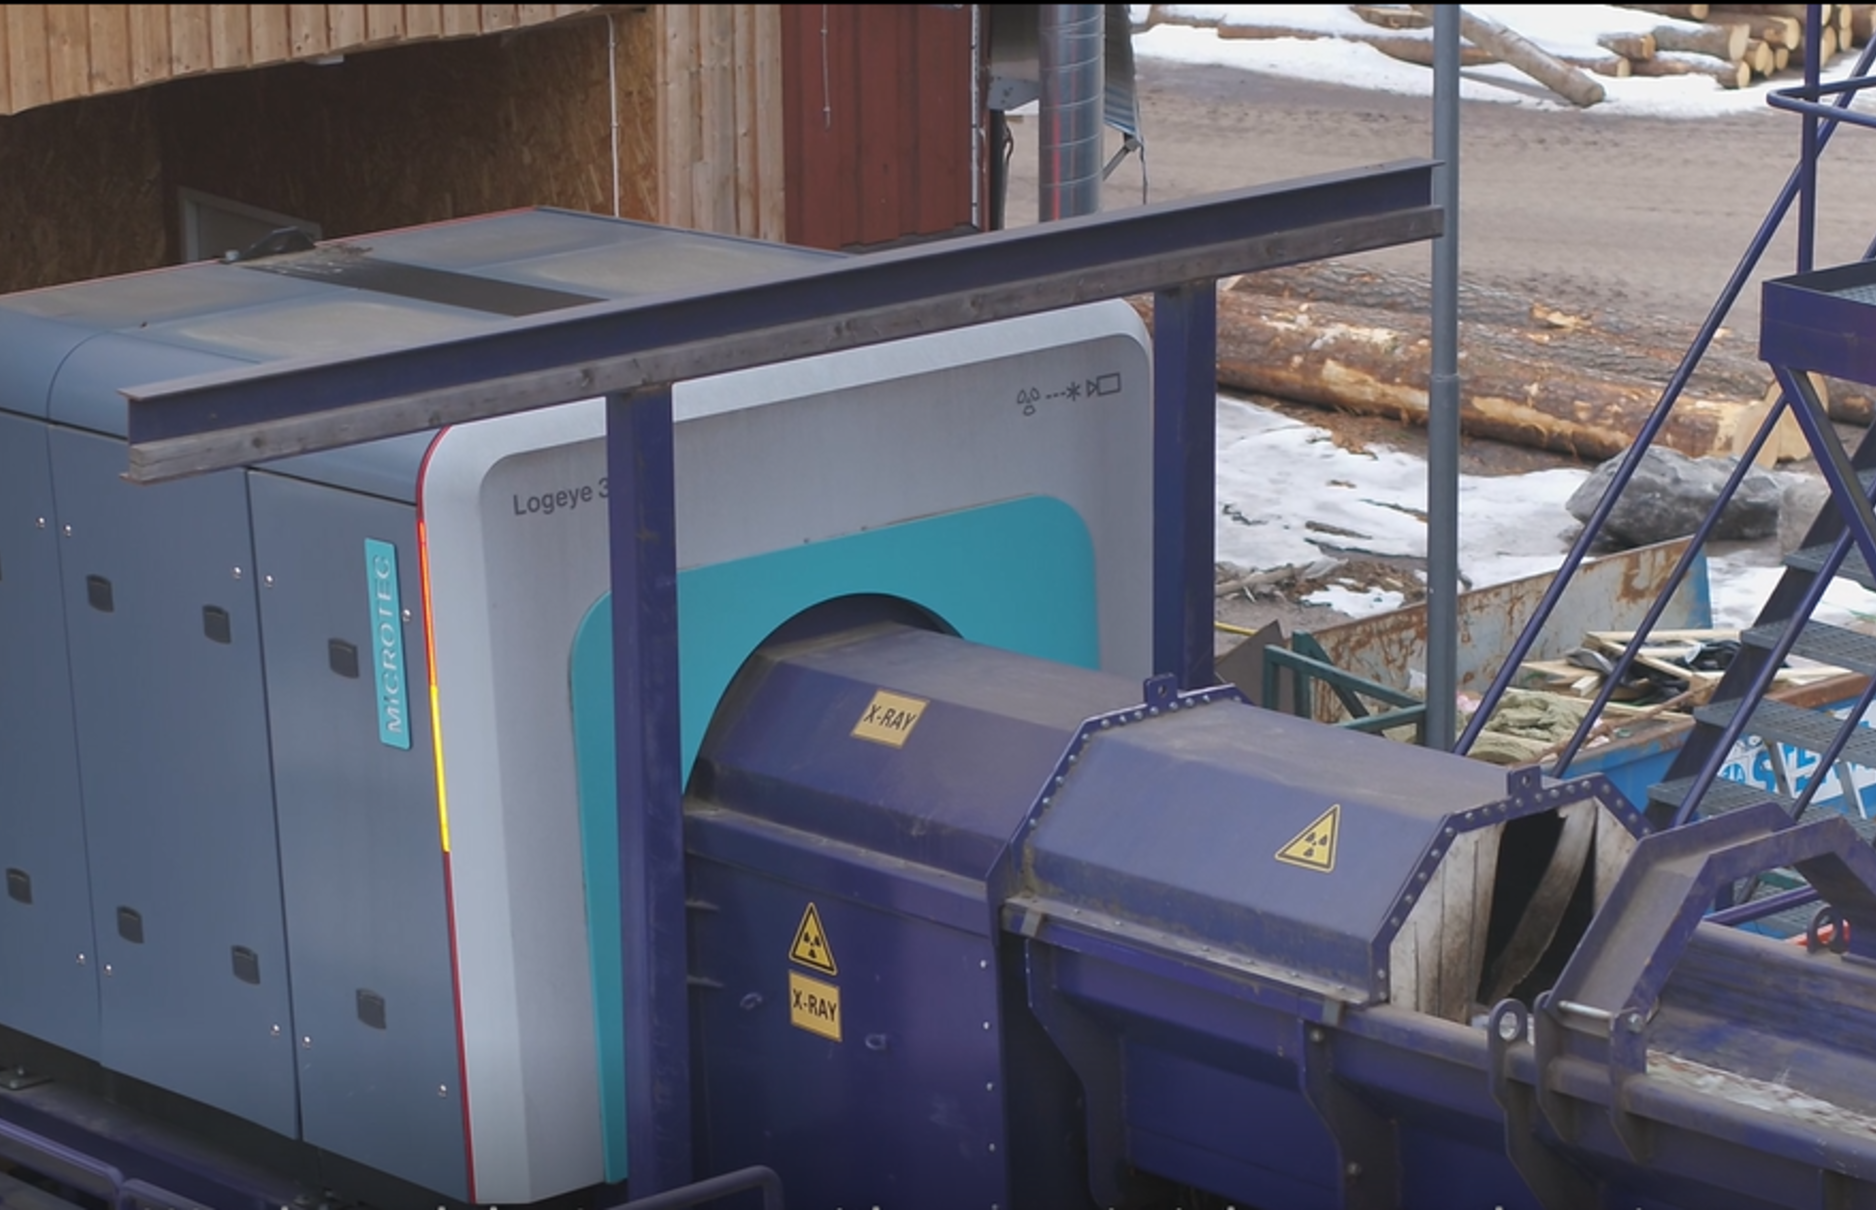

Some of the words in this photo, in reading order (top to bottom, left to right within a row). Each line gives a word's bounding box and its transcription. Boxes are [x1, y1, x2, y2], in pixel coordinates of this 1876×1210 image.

[512, 485, 593, 516] Logeye
[863, 704, 917, 731] X-RAY
[793, 988, 837, 1022] X-RAY
